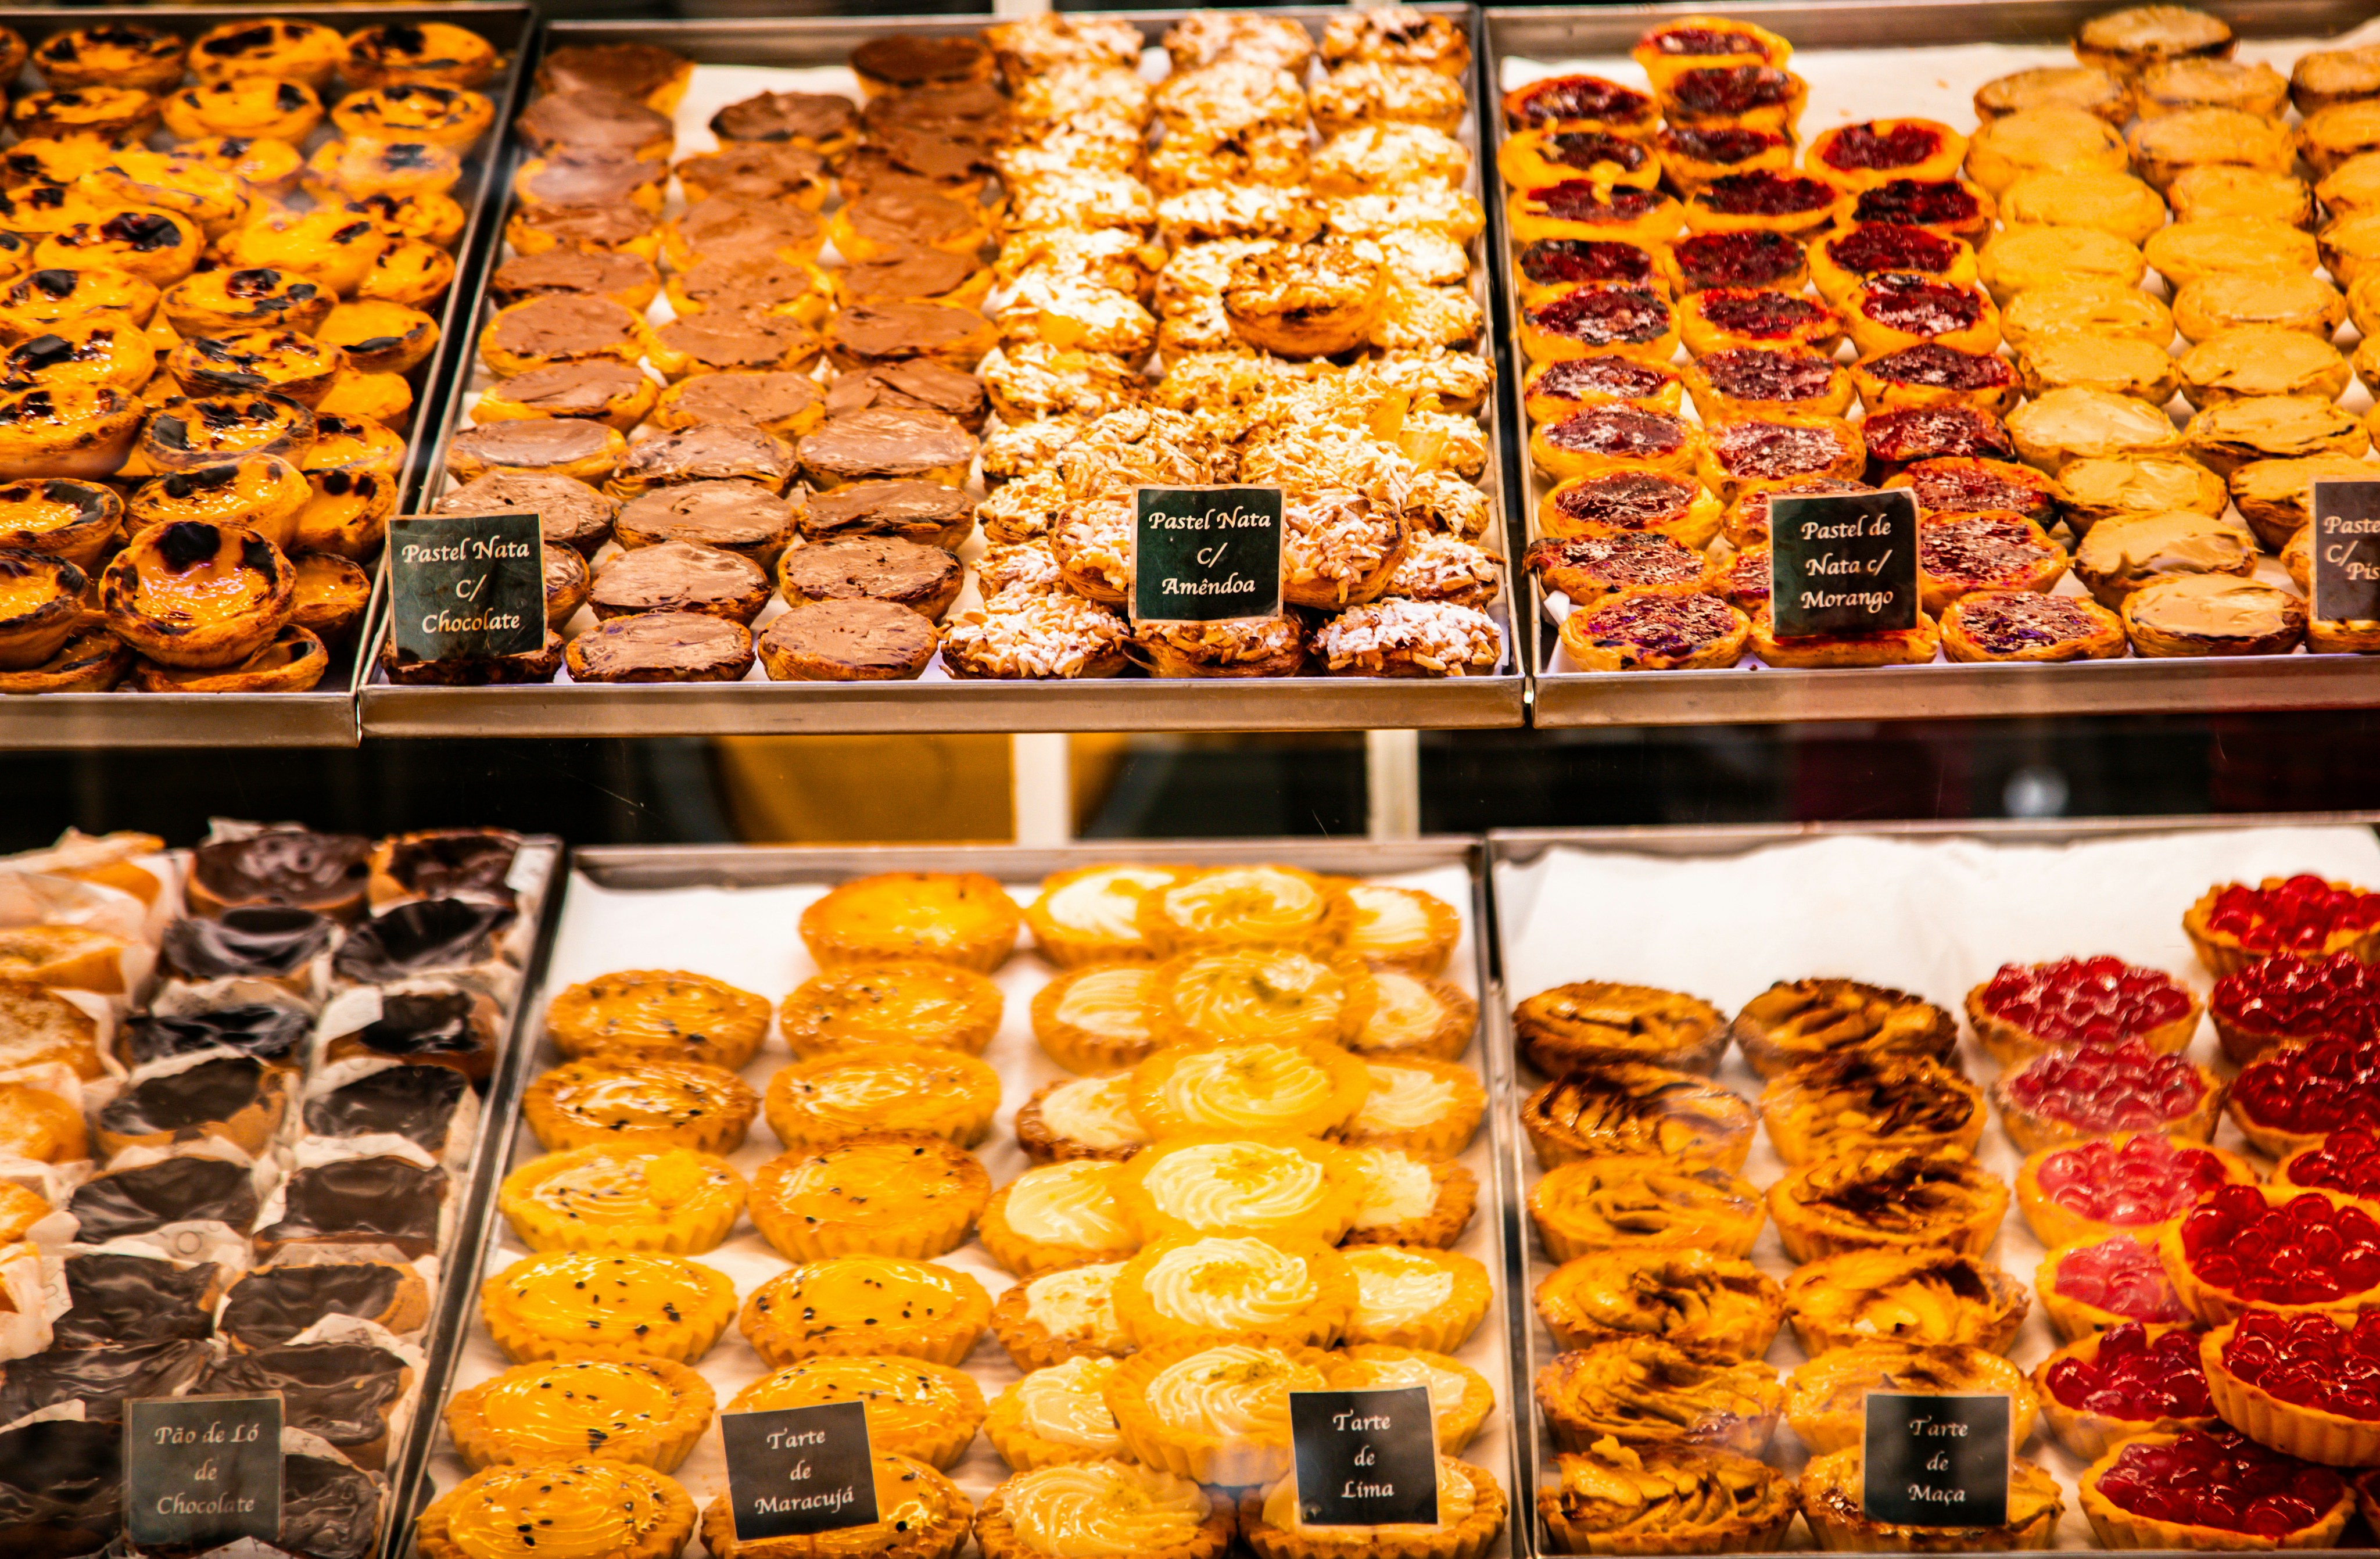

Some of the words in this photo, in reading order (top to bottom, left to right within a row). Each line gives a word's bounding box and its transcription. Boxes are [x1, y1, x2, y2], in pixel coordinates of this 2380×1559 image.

[1148, 508, 1216, 530] Pastel
[1216, 506, 1271, 529] Nata
[1801, 515, 1868, 540] Pastel
[1869, 513, 1891, 536] de
[402, 537, 471, 563] Pastel
[472, 535, 530, 559] Nata
[1197, 542, 1228, 568] C/
[2324, 540, 2359, 567] C/
[1805, 553, 1861, 576] Nata
[1867, 549, 1893, 576] c/
[456, 574, 487, 602] C/
[1162, 572, 1256, 595] Amêndoa
[1800, 590, 1894, 614] Morango
[422, 607, 520, 633] Chocolate
[1332, 1409, 1392, 1431] Tarte
[1909, 1415, 1969, 1438] Tarte
[154, 1426, 196, 1445] Pão
[202, 1421, 225, 1443] de
[230, 1423, 260, 1443] Ló
[766, 1427, 826, 1450] Tarte
[1354, 1445, 1375, 1466] de
[1926, 1450, 1949, 1471] de
[194, 1458, 218, 1481] de
[790, 1459, 812, 1481] de
[754, 1486, 855, 1514] Maracujá
[1341, 1481, 1395, 1499] Lima
[1908, 1483, 1966, 1507] Maça
[156, 1492, 255, 1515] Chocolate
